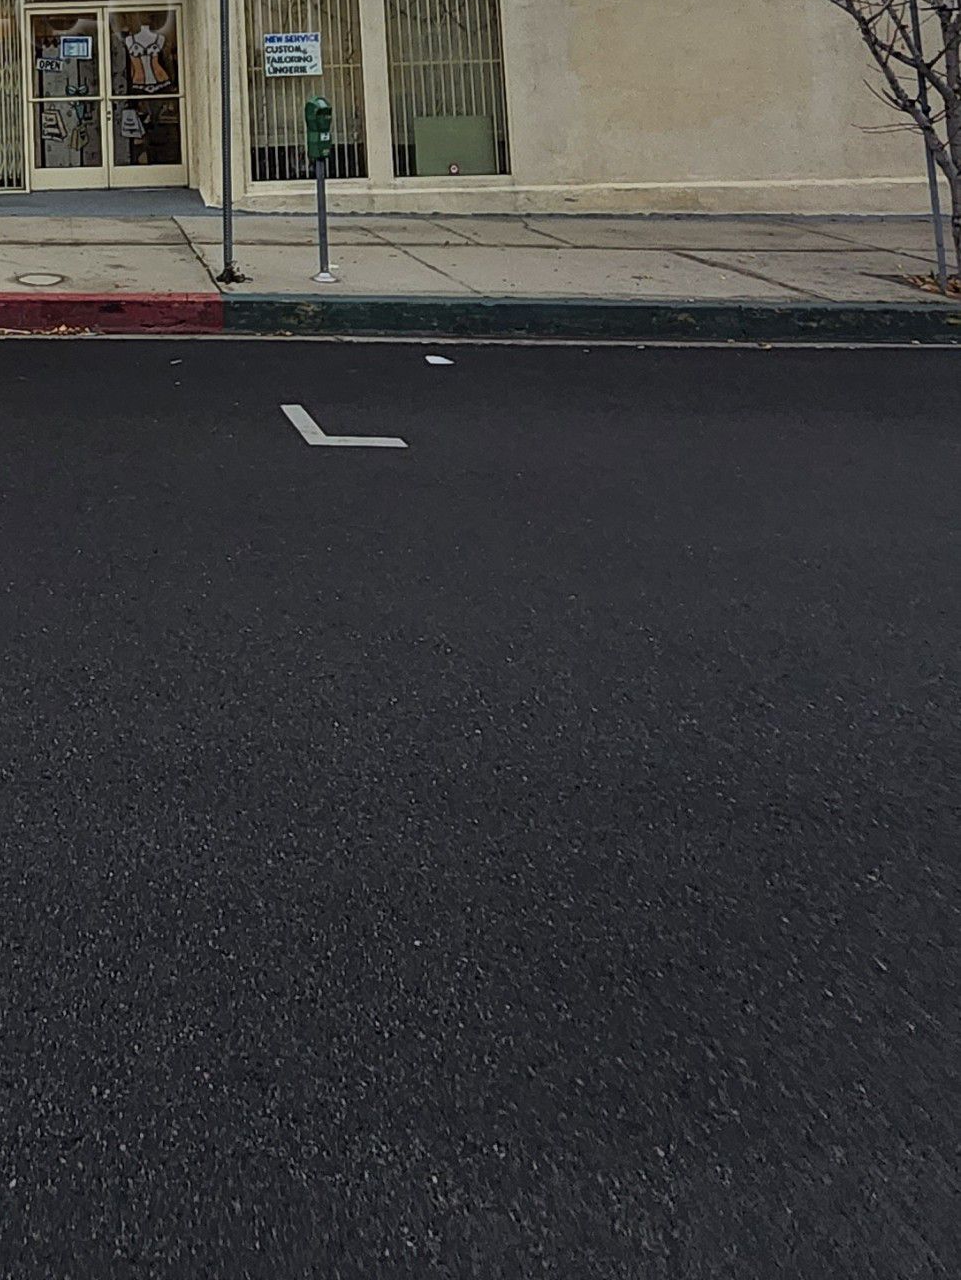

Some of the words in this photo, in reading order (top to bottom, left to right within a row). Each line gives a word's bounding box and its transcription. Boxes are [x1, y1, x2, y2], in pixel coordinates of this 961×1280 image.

[285, 34, 319, 42] SERVICE
[265, 46, 301, 54] CUSTOM
[266, 55, 313, 64] TAILORING
[39, 61, 60, 70] OPEN
[268, 66, 308, 74] LINGERIE
